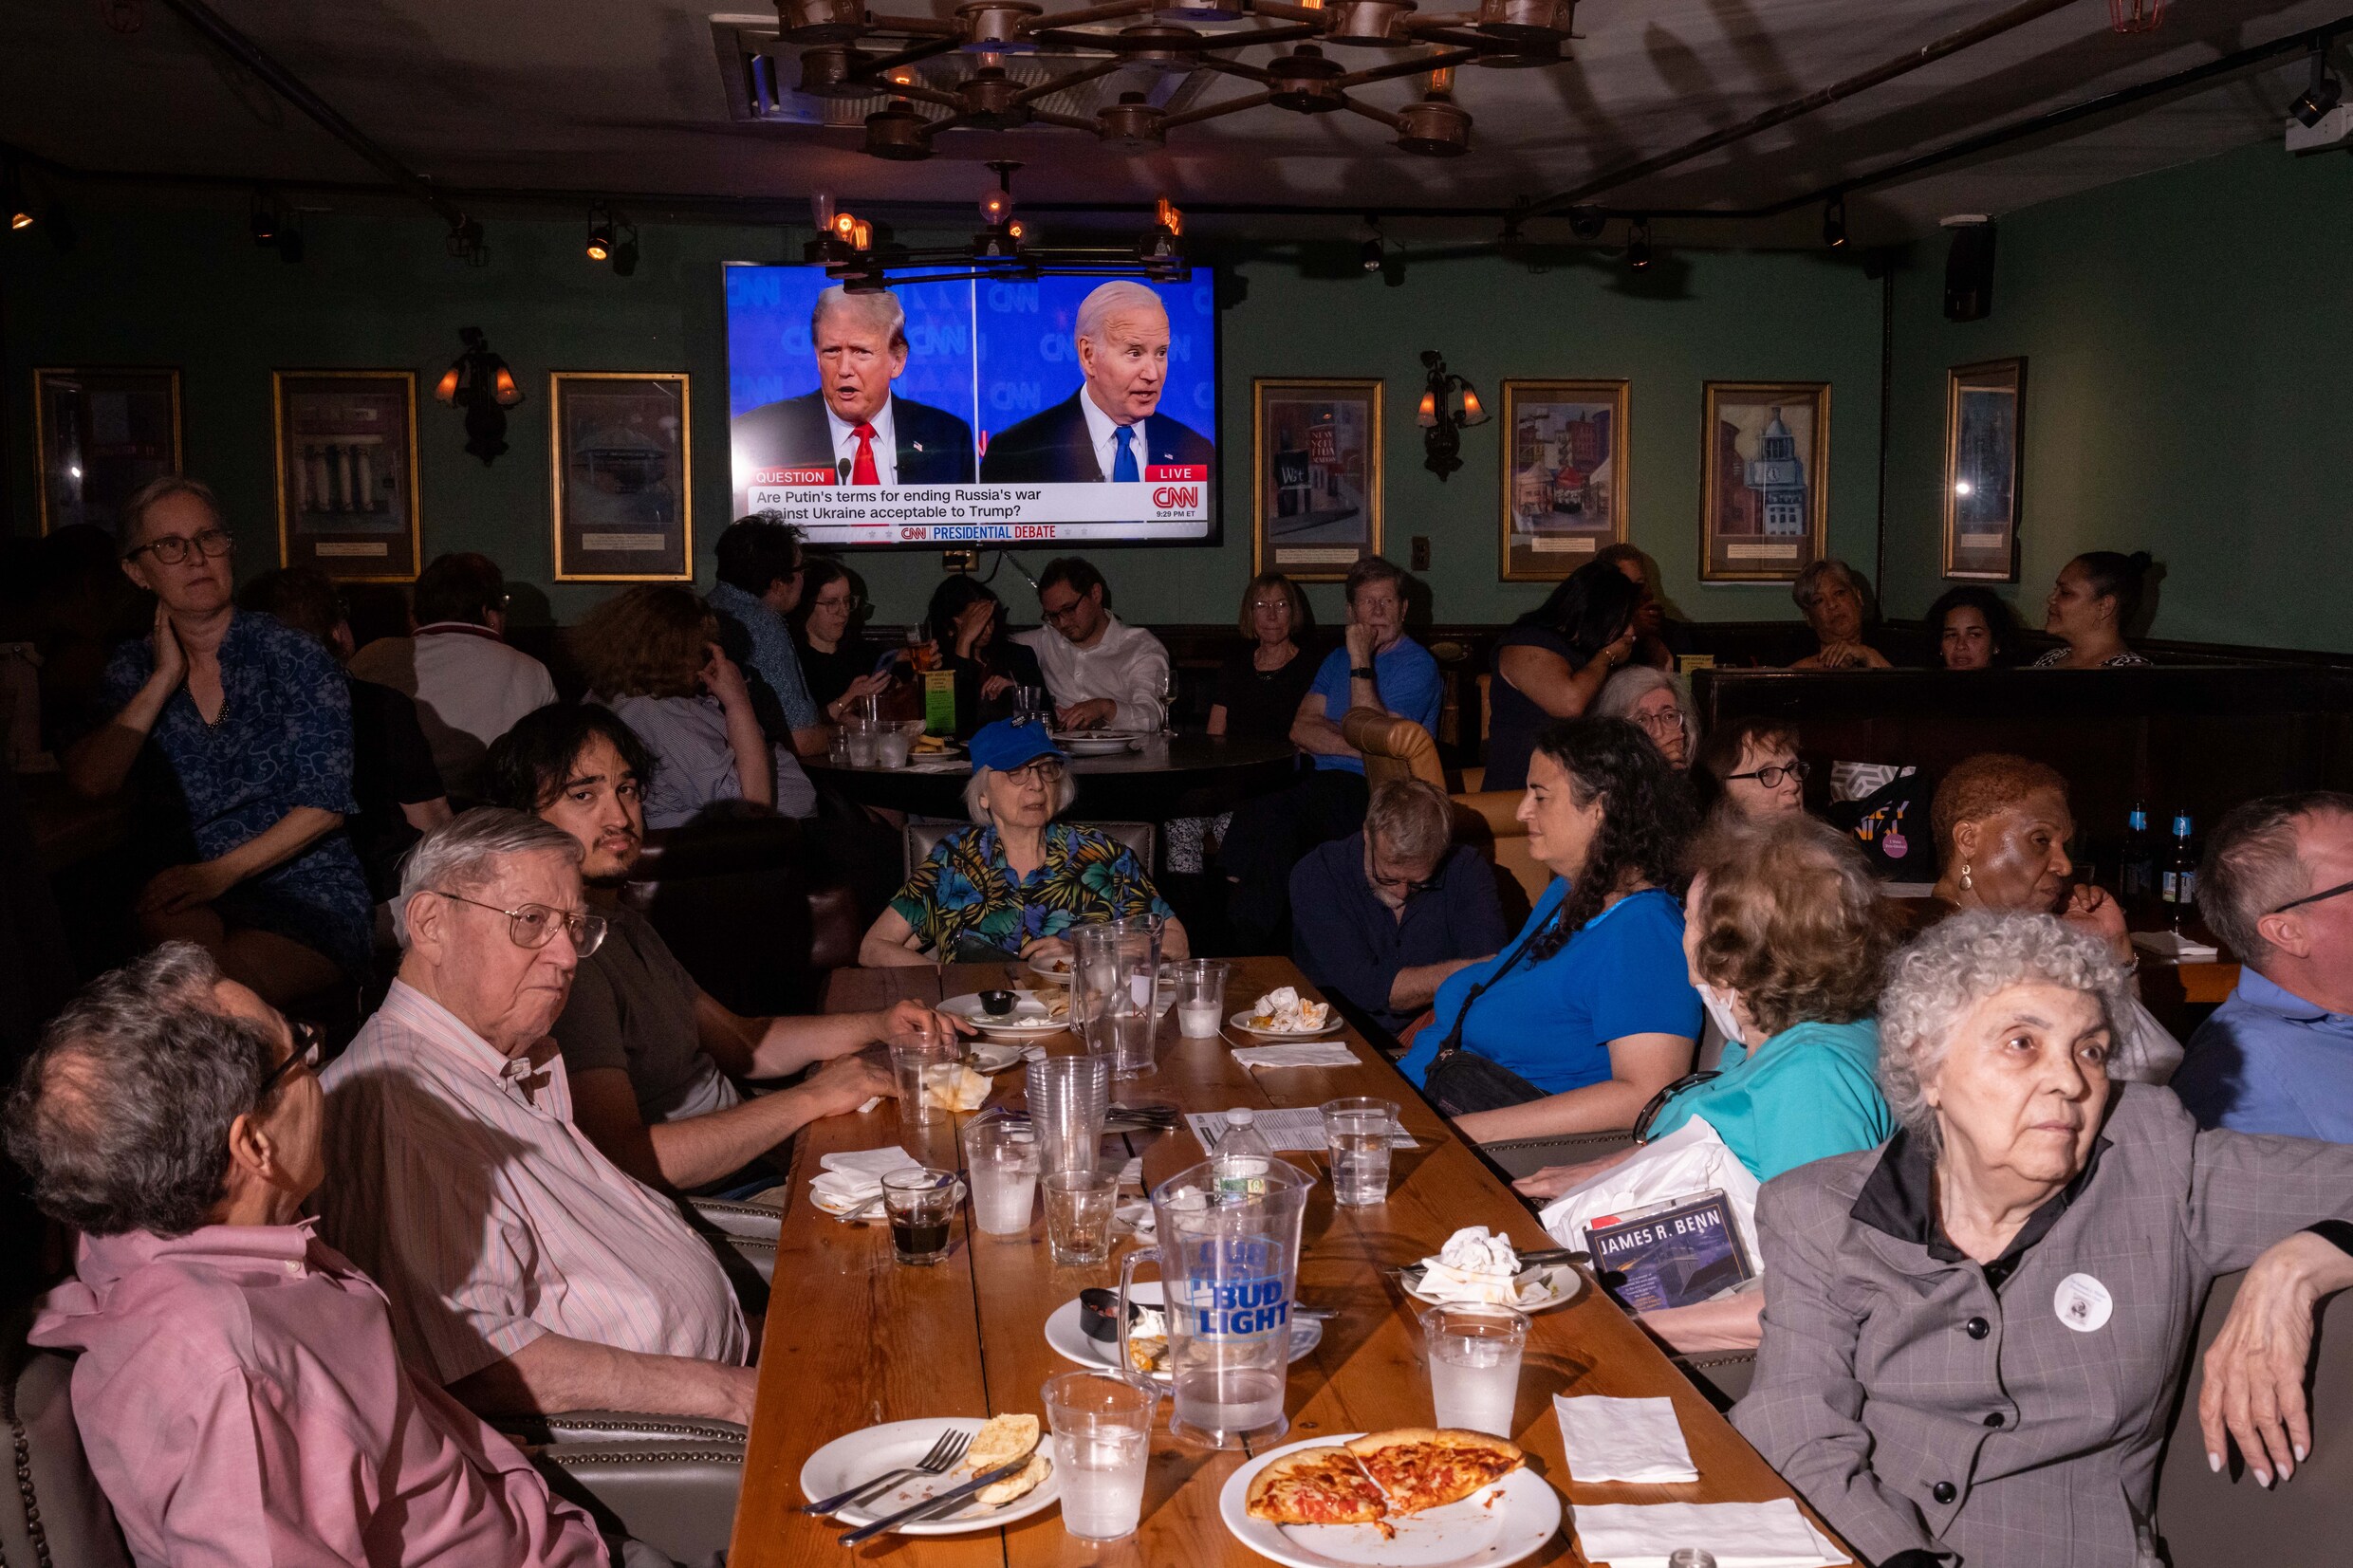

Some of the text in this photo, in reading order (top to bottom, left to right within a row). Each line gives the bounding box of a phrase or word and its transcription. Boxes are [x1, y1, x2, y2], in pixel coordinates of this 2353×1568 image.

[756, 471, 824, 483] QUESTION
[1160, 468, 1192, 479] LIVE
[757, 489, 1042, 504] Are Putin's terms for ending Russia's war
[1153, 487, 1198, 508] CNN
[813, 507, 865, 519] Ukraine
[870, 506, 947, 521] acceptable
[952, 507, 965, 518] to
[969, 505, 1021, 519] Trump?
[900, 526, 927, 540] CNN
[934, 526, 1056, 539] PRESIDENTIAL DEBATE
[1601, 1209, 1721, 1255] JAMES R. BENN
[1213, 1281, 1283, 1310] BUD
[1199, 1300, 1289, 1336] LIGHT
